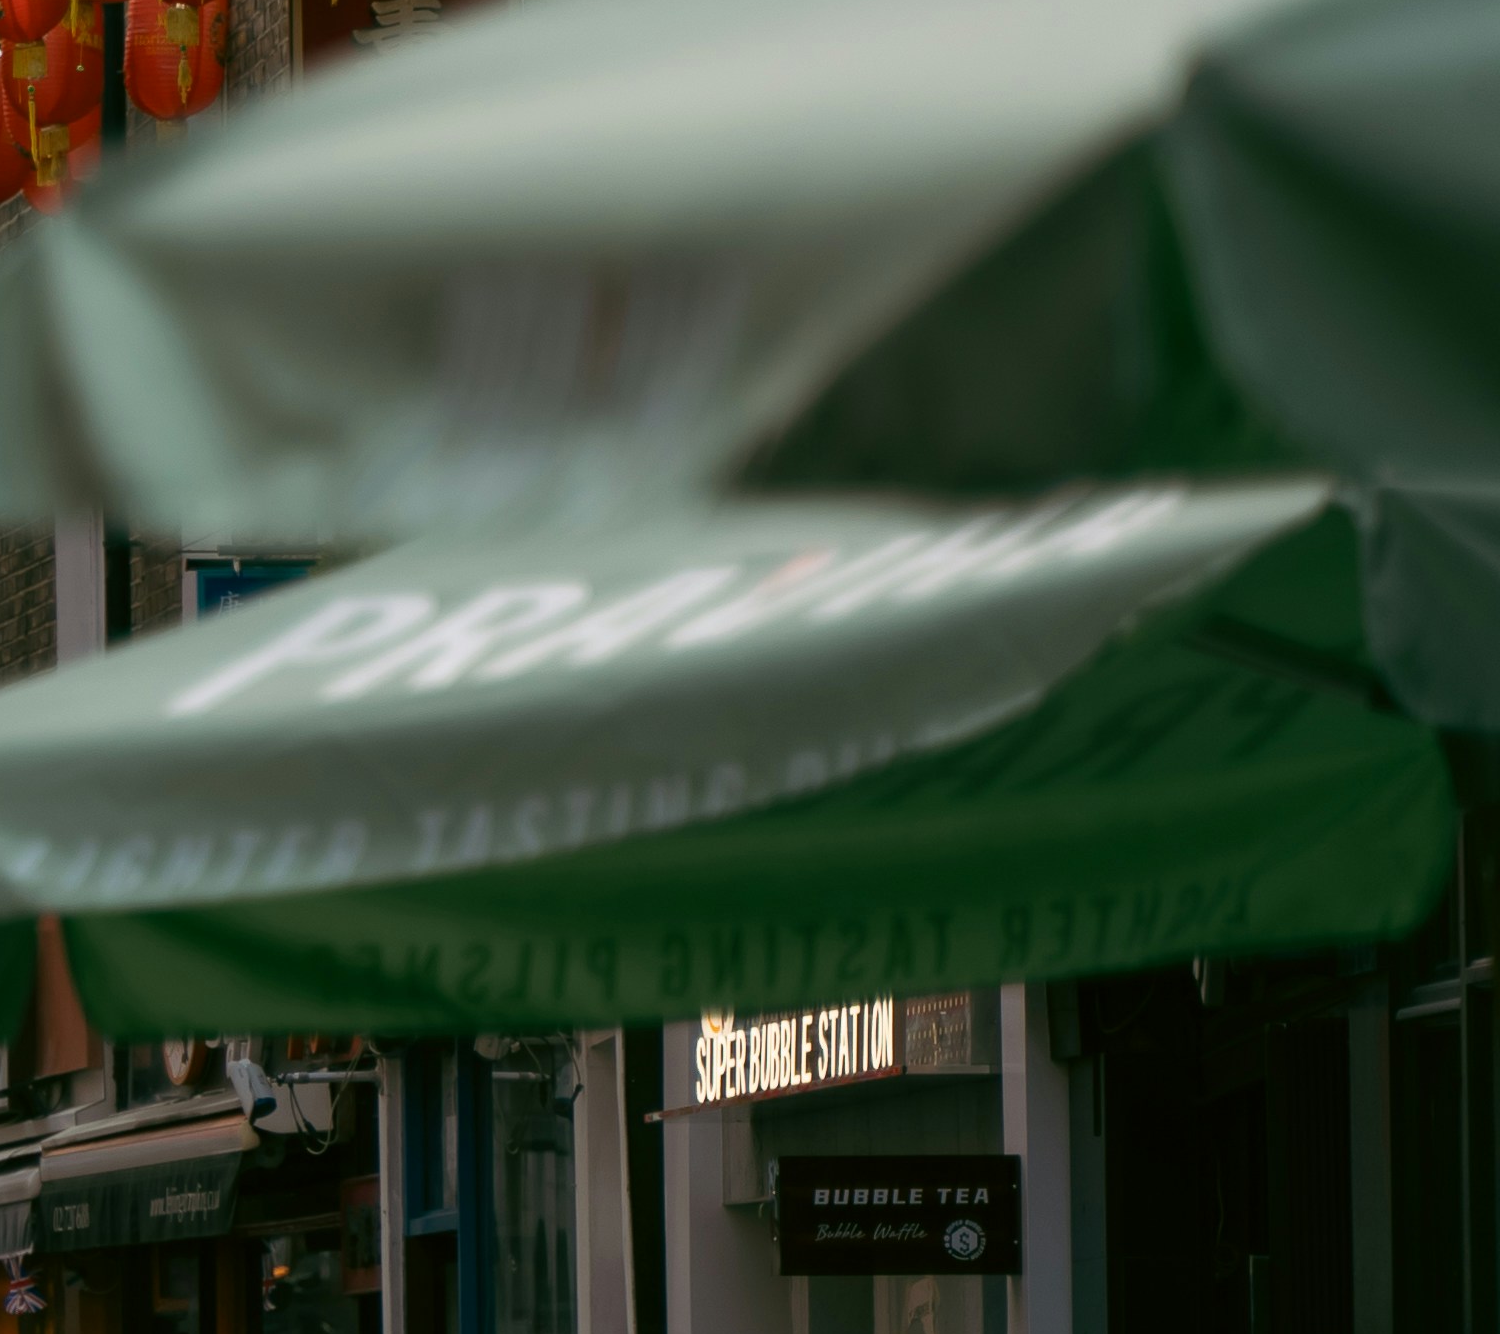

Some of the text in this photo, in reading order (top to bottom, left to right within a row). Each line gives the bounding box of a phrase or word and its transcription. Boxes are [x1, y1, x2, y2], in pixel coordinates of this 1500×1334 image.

[695, 992, 895, 1104] SUPER BUBBLE STATION
[813, 1187, 990, 1206] BUBBLE TEA
[814, 1222, 929, 1242] Bubble Waffle
